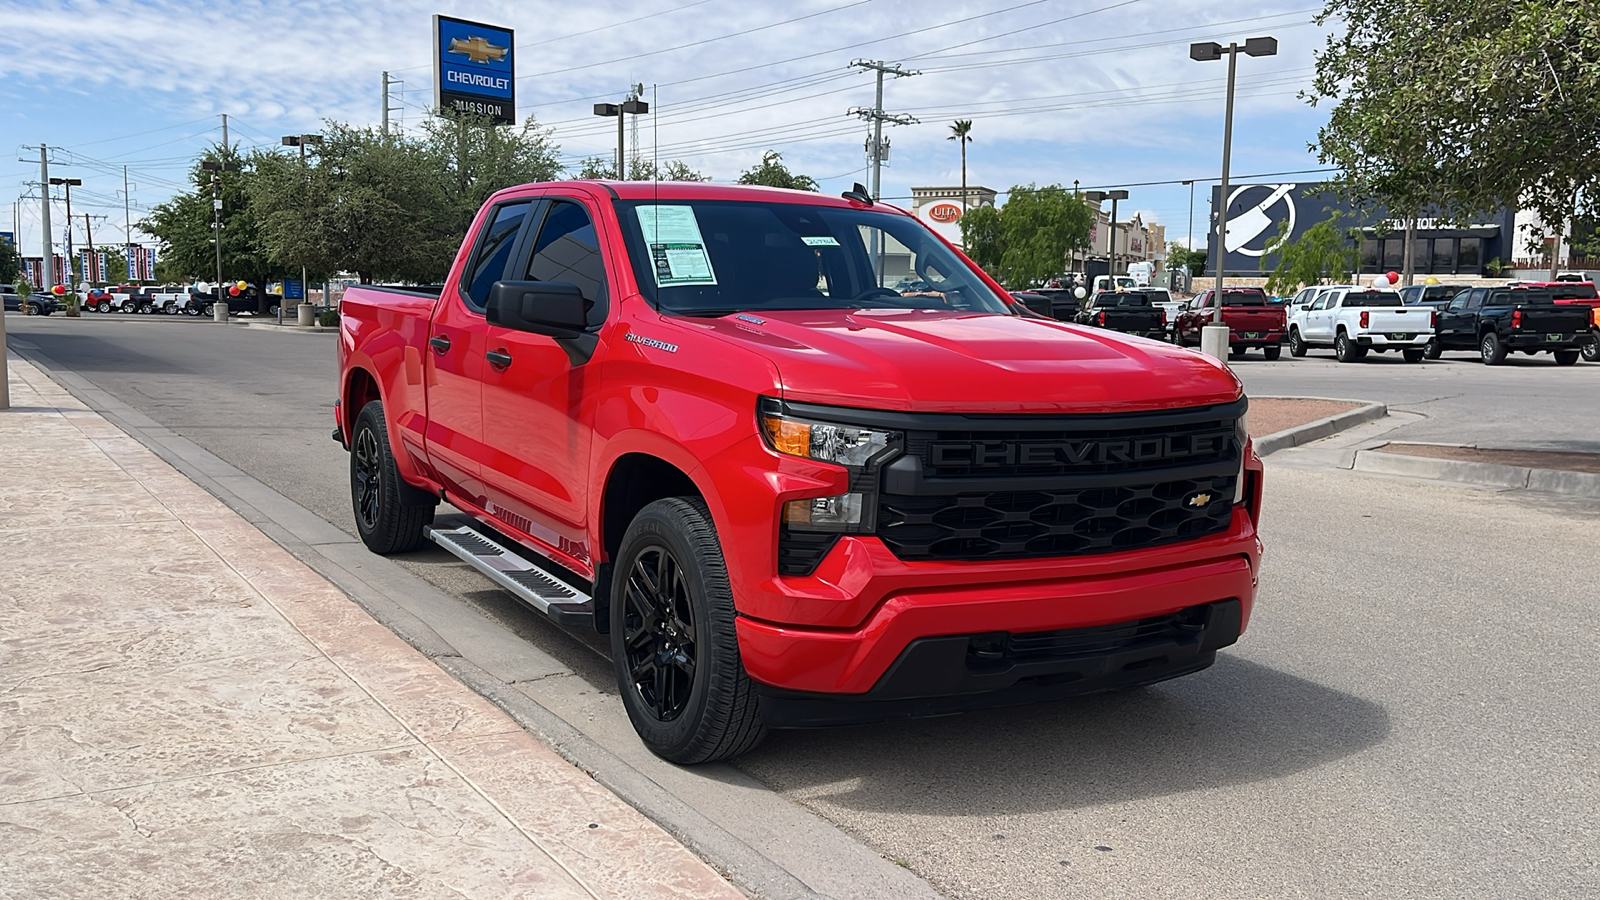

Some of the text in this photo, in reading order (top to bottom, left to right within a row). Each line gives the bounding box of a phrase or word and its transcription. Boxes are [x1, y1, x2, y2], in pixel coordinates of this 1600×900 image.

[447, 70, 509, 90] CHEVROLET
[454, 99, 502, 116] MISSION
[934, 207, 957, 216] ULTA
[624, 332, 678, 353] SILVERADO
[931, 432, 1233, 465] CHEVROLET
